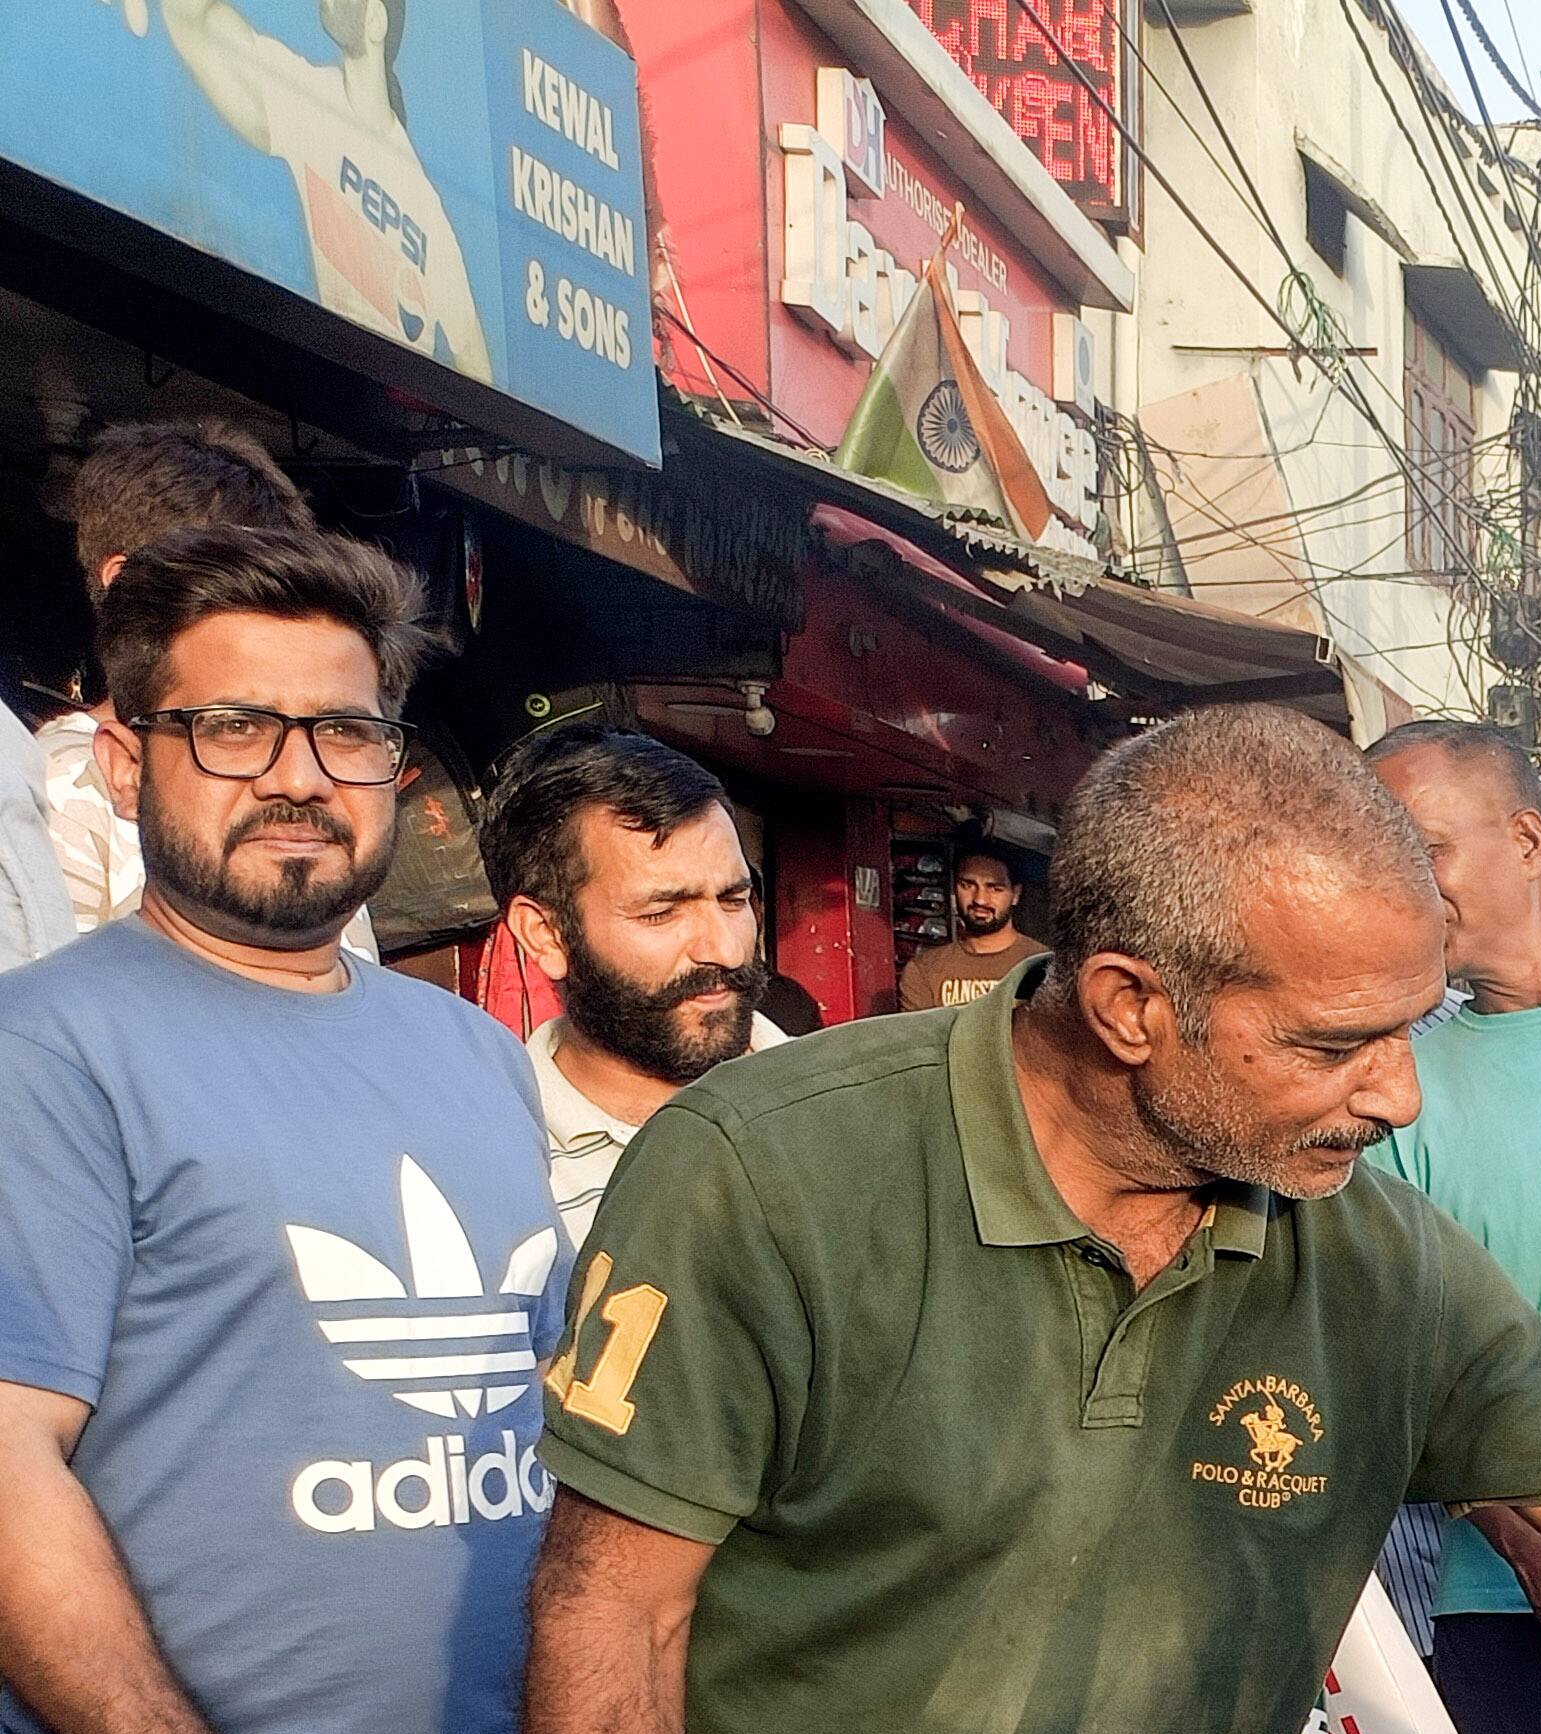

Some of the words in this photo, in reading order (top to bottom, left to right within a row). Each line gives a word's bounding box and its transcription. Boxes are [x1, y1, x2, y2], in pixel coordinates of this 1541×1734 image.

[523, 48, 619, 171] KEWAL
[340, 155, 427, 276] PEPSI
[512, 146, 635, 277] KRISHAN
[961, 230, 1008, 295] DEALER
[526, 260, 549, 329] &
[557, 278, 631, 369] SONS
[1208, 1379, 1257, 1427] SANTA
[1265, 1375, 1324, 1444] BARBARA
[1192, 1462, 1239, 1484] POLO
[1241, 1470, 1255, 1486] &
[1256, 1471, 1328, 1495] RACQUET
